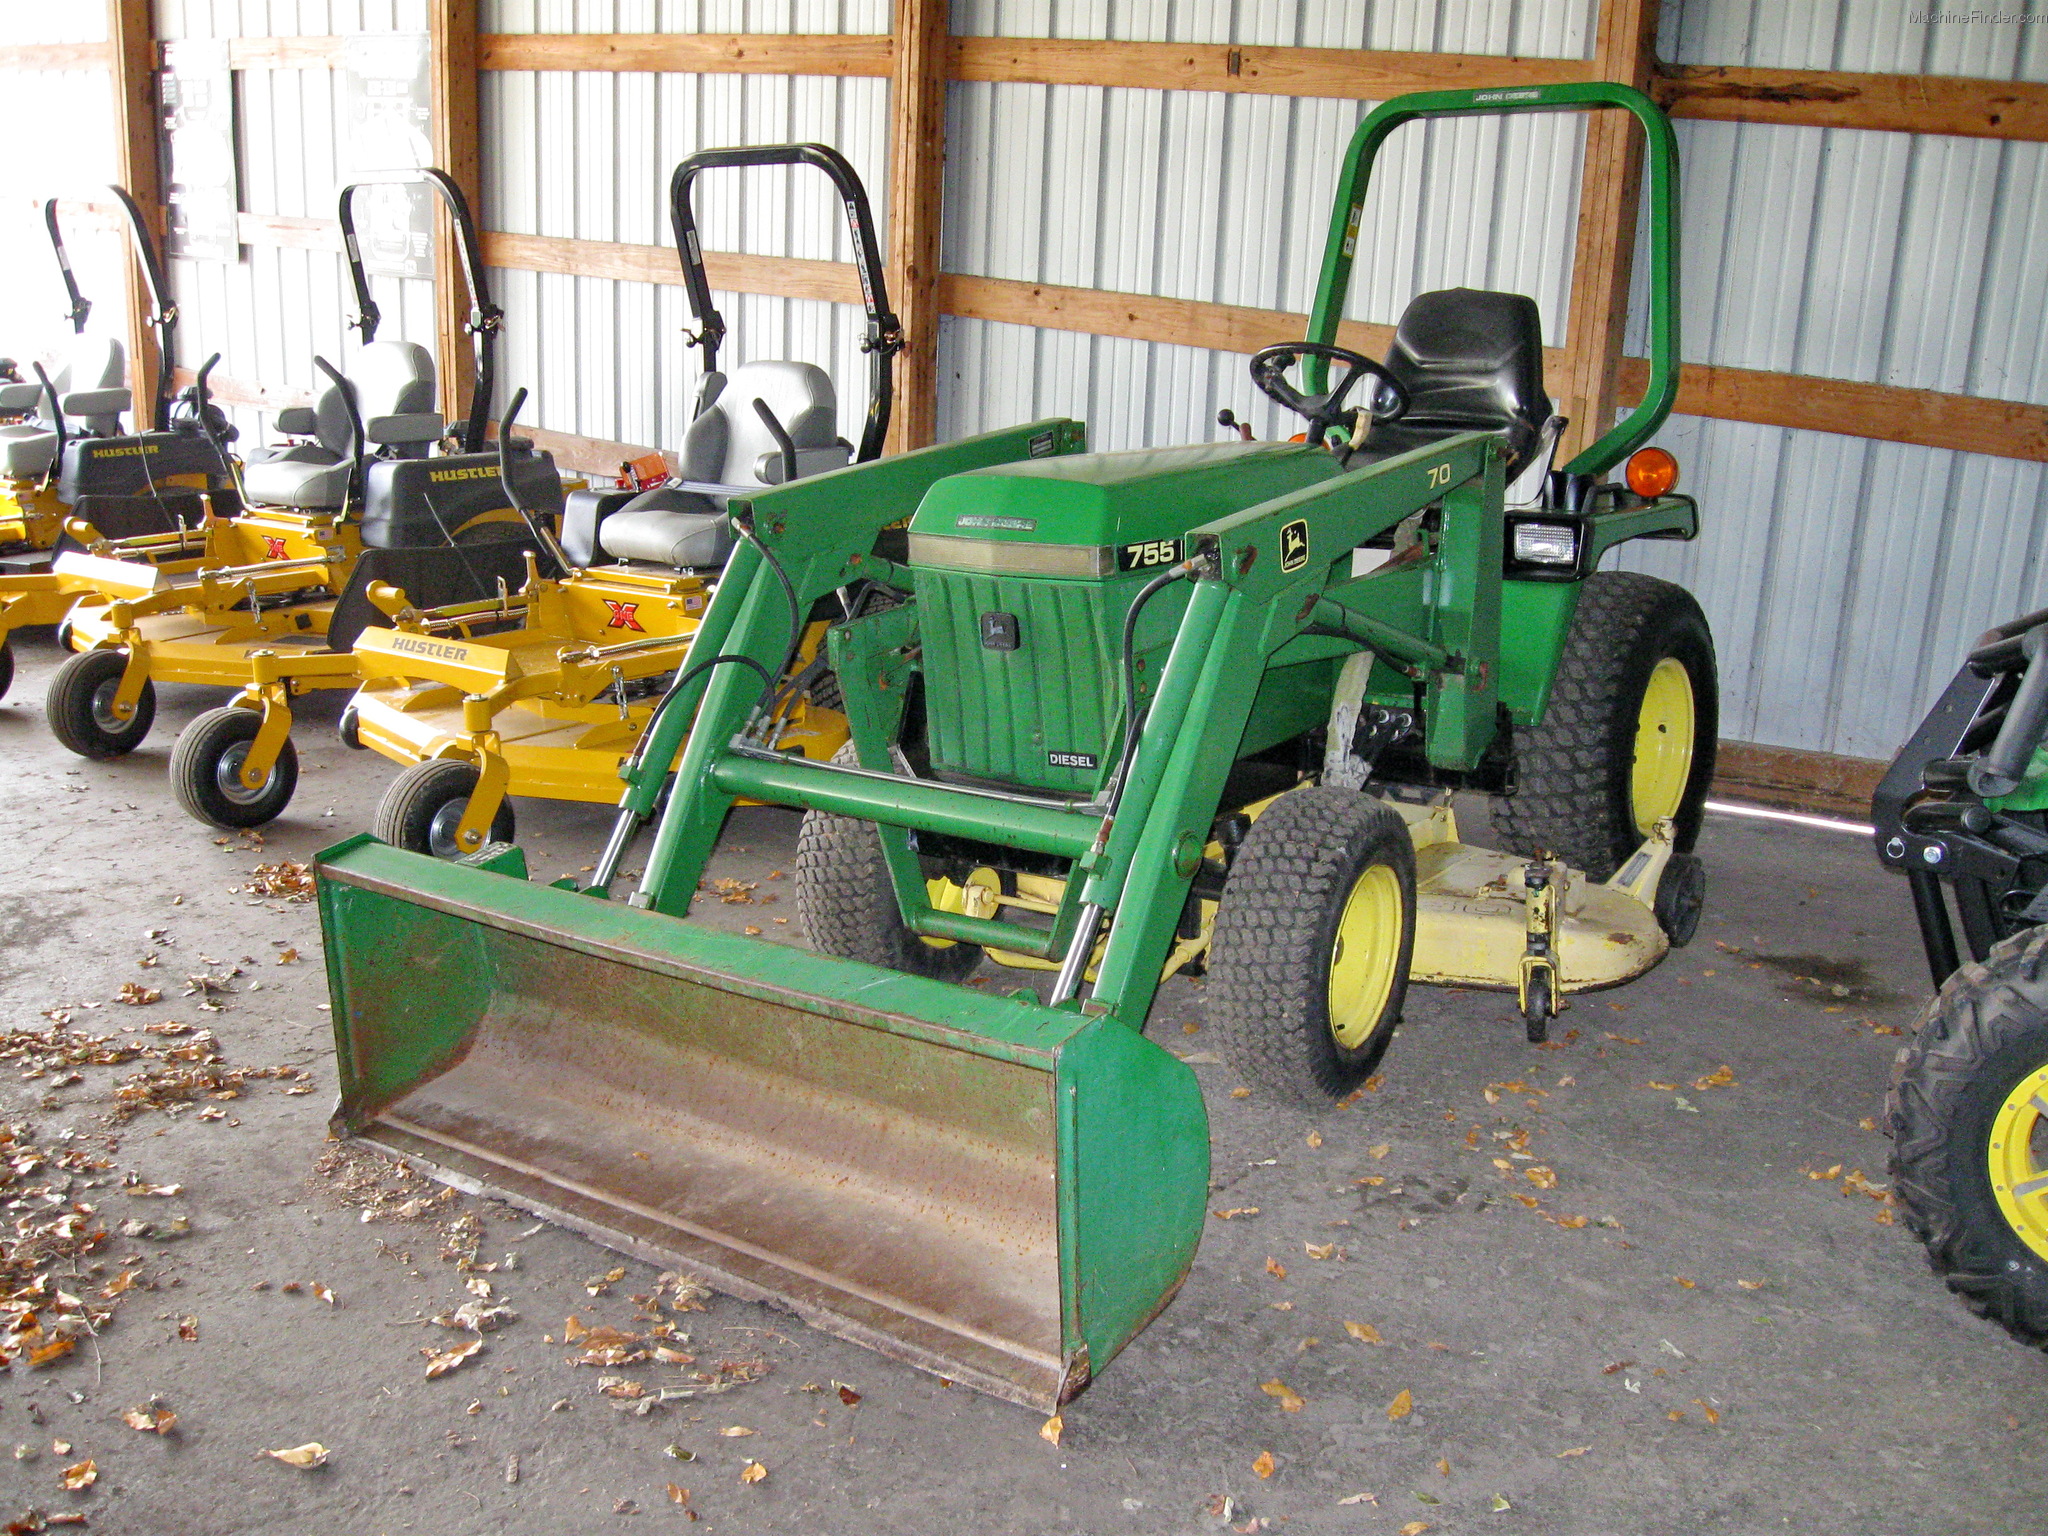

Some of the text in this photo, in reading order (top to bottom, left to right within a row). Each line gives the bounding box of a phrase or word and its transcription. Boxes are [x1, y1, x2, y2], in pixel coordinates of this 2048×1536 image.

[1475, 93, 1503, 102] JOHN
[1427, 463, 1450, 490] 70
[1127, 540, 1175, 568] 755
[392, 637, 468, 661] HUSTLER
[1049, 754, 1094, 767] DIESEL
